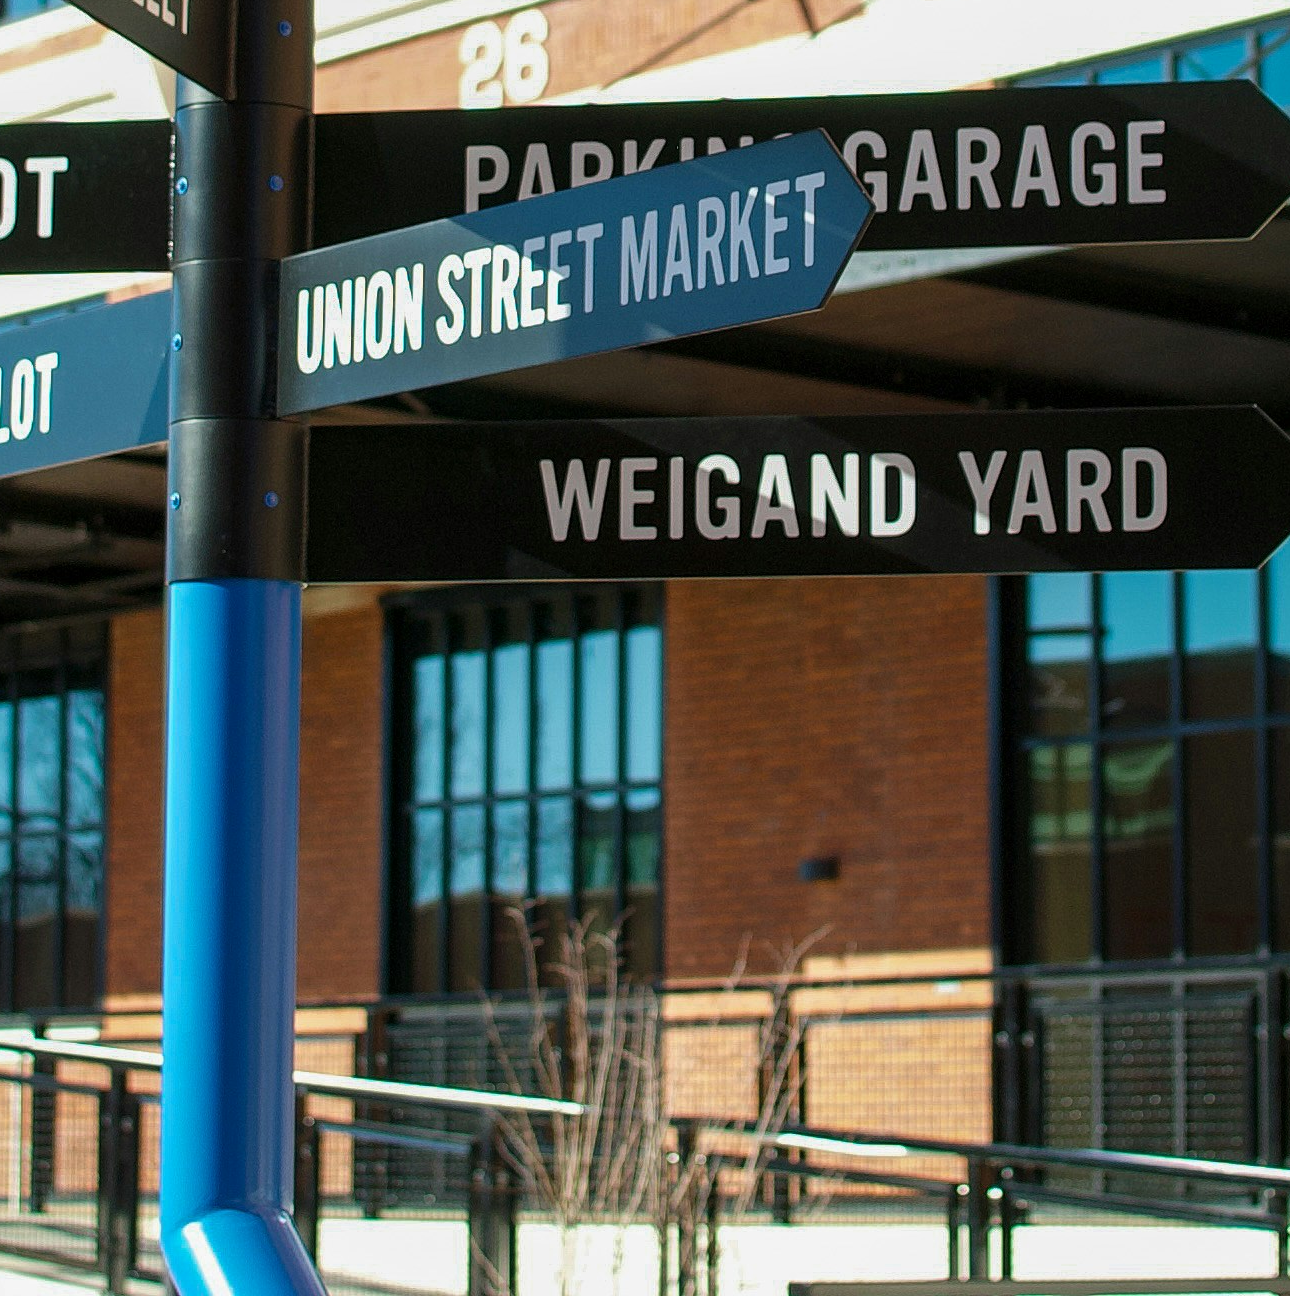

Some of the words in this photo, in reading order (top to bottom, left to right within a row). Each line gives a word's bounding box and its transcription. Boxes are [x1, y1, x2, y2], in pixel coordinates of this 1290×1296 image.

[459, 10, 551, 109] 26
[844, 119, 1167, 213] GARAGE
[295, 262, 425, 374] UNION
[436, 223, 604, 345] STREET
[619, 171, 826, 306] MARKET
[540, 453, 916, 543] WEIGAND
[958, 447, 1168, 535] YARD
